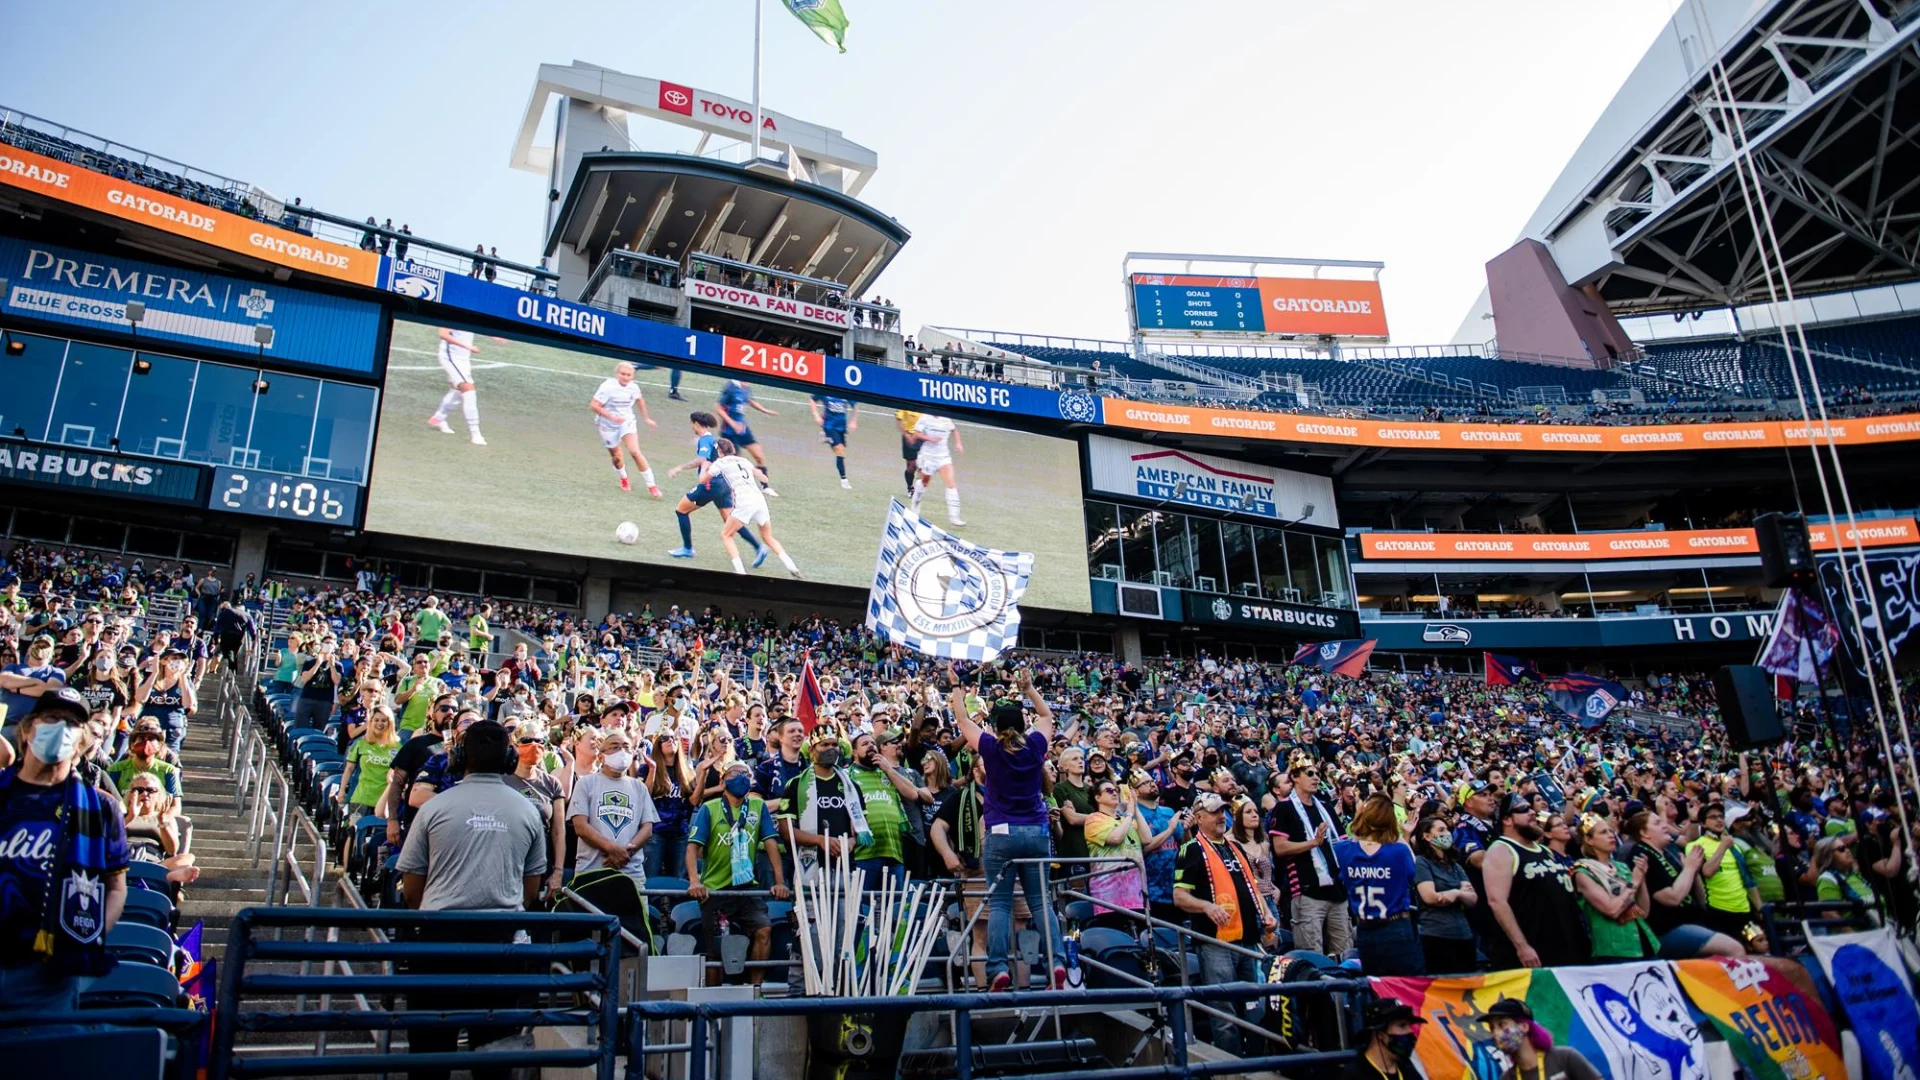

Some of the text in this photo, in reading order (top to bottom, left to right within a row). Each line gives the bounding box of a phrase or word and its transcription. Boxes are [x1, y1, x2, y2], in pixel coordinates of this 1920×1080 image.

[700, 99, 777, 131] TOYOA
[107, 190, 216, 233] GATORADE
[249, 232, 349, 270] GATORADE
[22, 249, 217, 309] PREMERA
[396, 260, 440, 281] OL REIGN
[17, 292, 125, 320] BLUE CROSS
[694, 283, 847, 325] TOYOTA FAN DECK
[1272, 297, 1372, 315] GATORADE
[517, 296, 606, 338] OL REIGN
[685, 335, 697, 356] 1
[740, 344, 809, 376] 21:06
[844, 365, 862, 386] 0
[919, 378, 1010, 408] THORNS FC
[1126, 409, 1191, 425] GATORADE
[1211, 417, 1276, 431] GATORADE
[1296, 423, 1358, 437] GATORADE
[1377, 429, 1441, 440] GATORADE
[1460, 431, 1522, 442] GATORADE
[1542, 433, 1602, 443] GATORADE
[1621, 432, 1683, 444] GATORADE
[1703, 429, 1765, 441] GATORADE
[223, 474, 344, 520] 21:06
[1222, 479, 1273, 501] FAMILY
[1375, 540, 1435, 551] GATORADE
[1455, 541, 1513, 551] GATORADE
[1533, 541, 1590, 551] GATORADE
[1610, 538, 1669, 550] GATORADE
[1688, 535, 1748, 547] GATORADE
[989, 579, 1001, 610] GROUP
[913, 615, 931, 630] EST.
[1241, 605, 1336, 628] STARBUCKS
[366, 749, 392, 766] XBO
[718, 832, 755, 845] XBX
[1347, 866, 1390, 880] RAPINOE
[1355, 886, 1387, 920] 15
